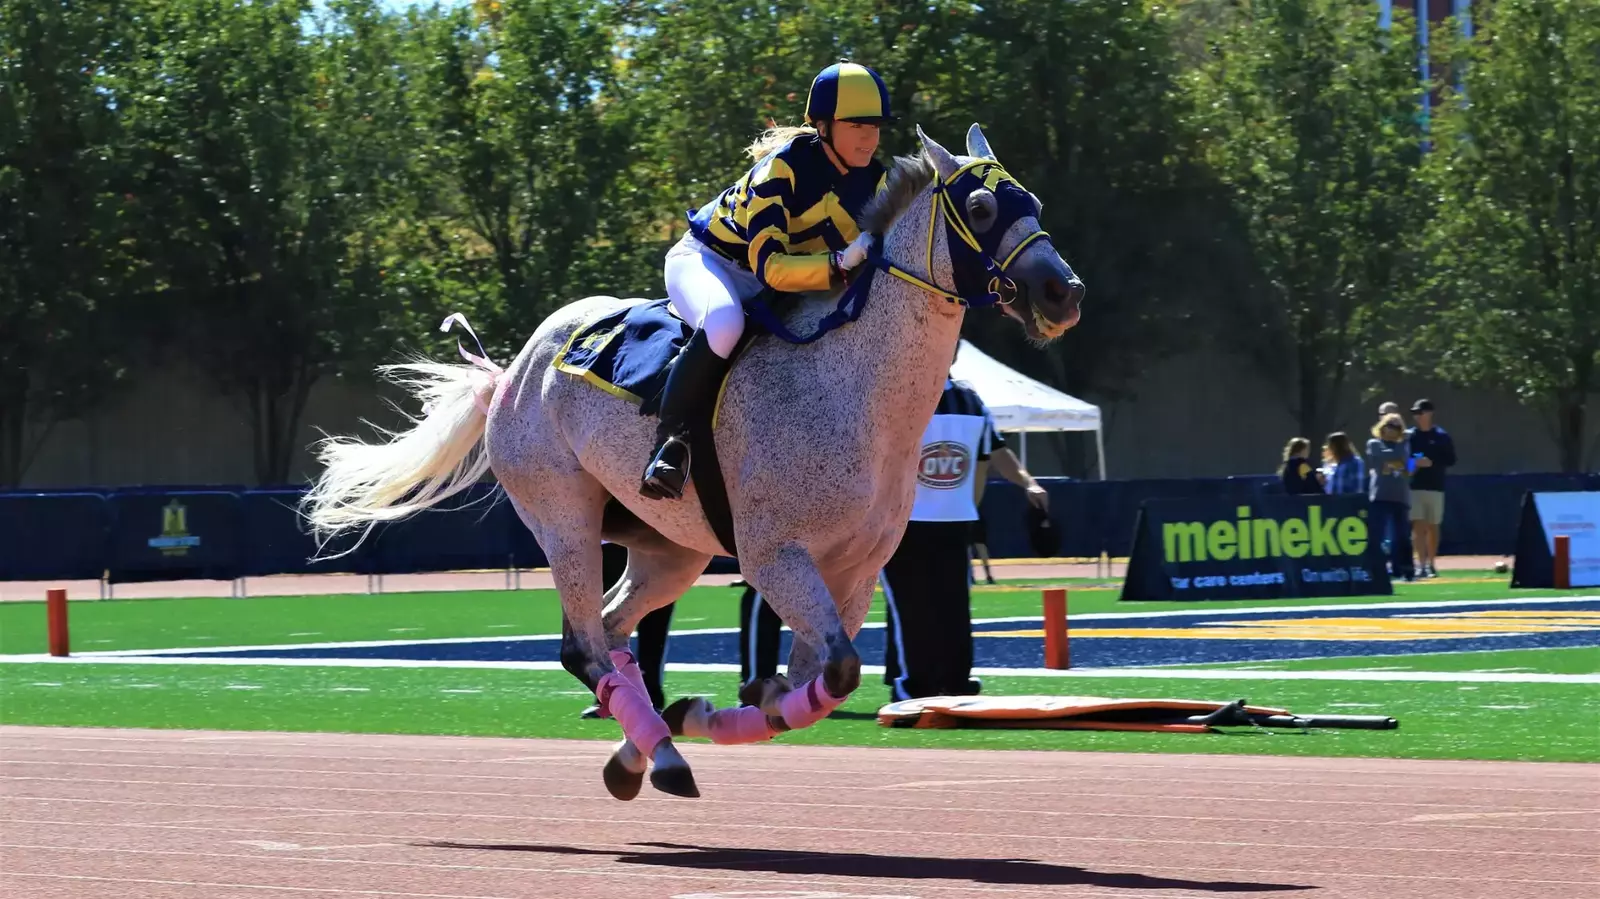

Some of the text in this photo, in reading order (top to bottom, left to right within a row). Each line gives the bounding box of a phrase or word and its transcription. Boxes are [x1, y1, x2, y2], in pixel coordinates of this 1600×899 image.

[923, 457, 963, 475] OVC
[1162, 505, 1368, 562] meineke
[1193, 575, 1227, 588] care
[1229, 571, 1285, 587] centers
